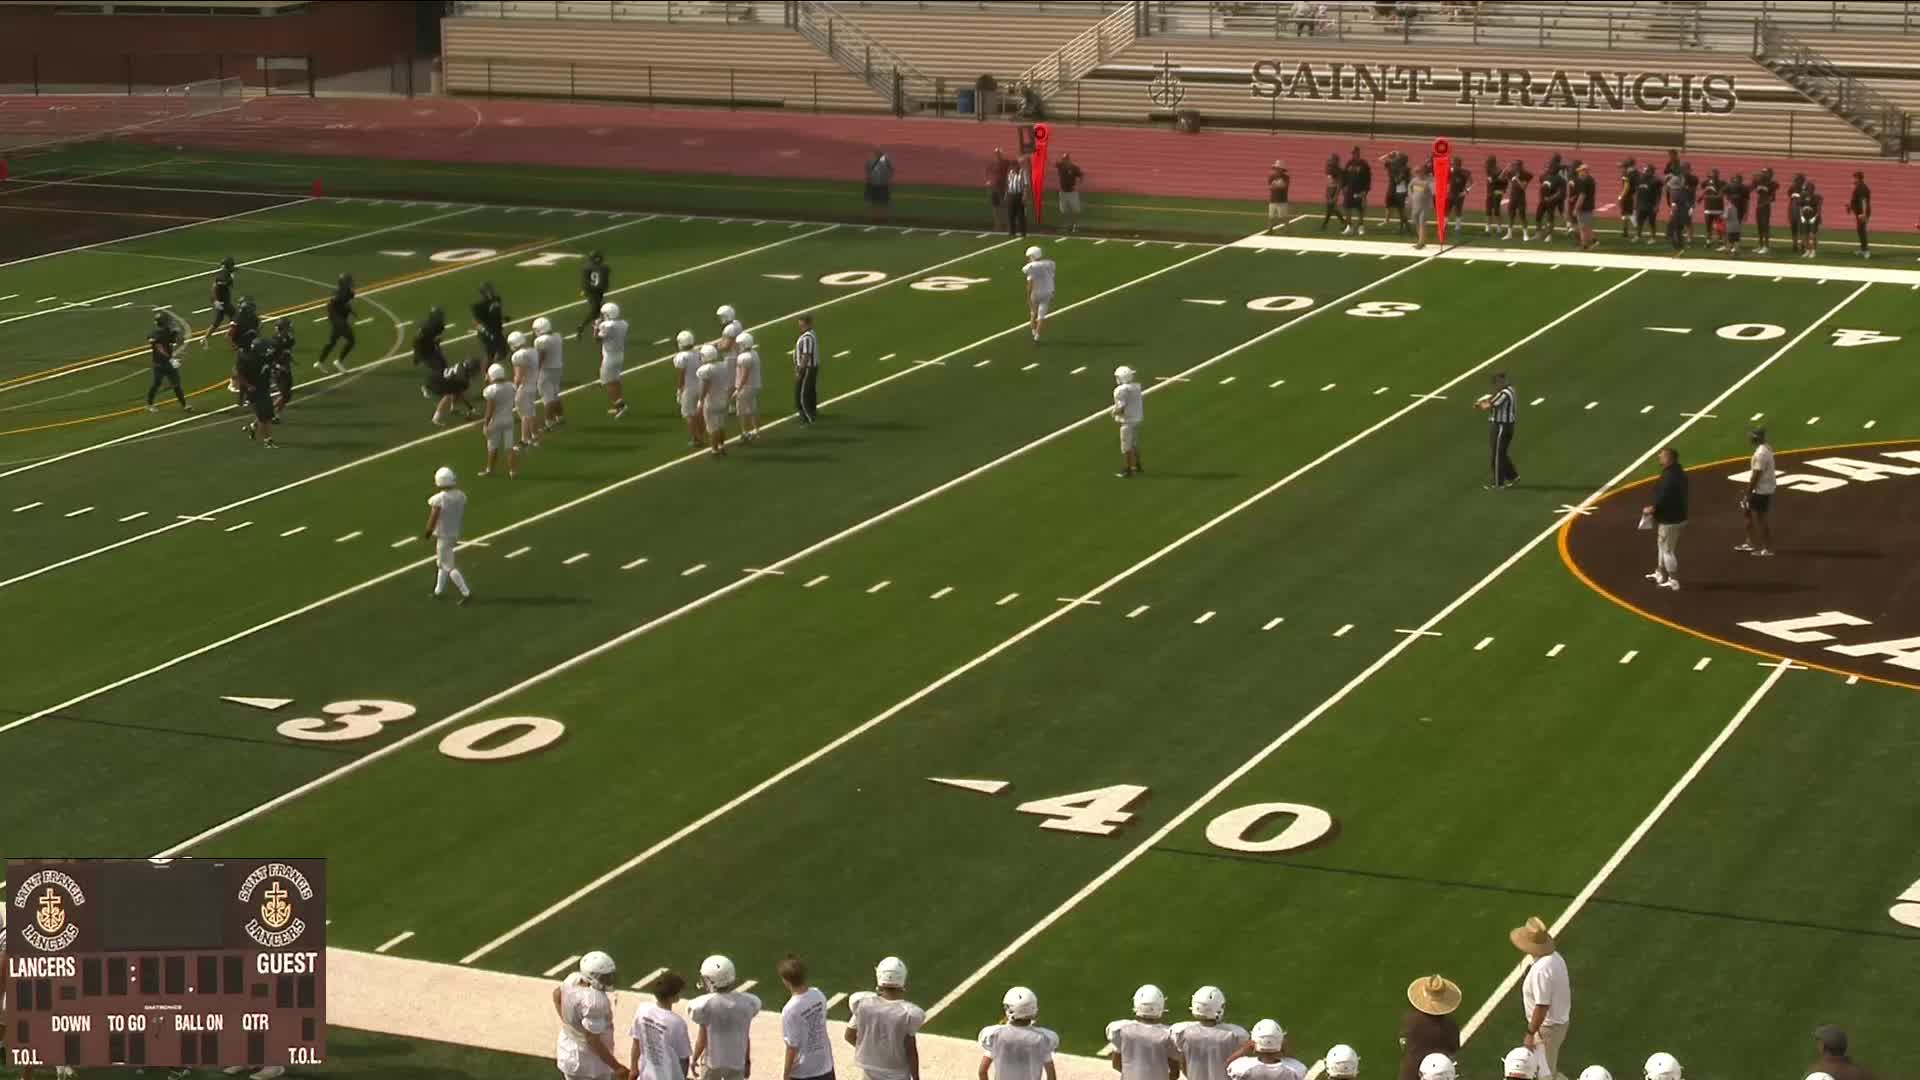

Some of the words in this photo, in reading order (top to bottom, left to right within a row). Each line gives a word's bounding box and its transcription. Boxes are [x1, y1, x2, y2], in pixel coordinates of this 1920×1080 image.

[1250, 59, 1433, 104] SAINT
[1456, 66, 1738, 115] FRANCIS
[590, 272, 600, 287] 9
